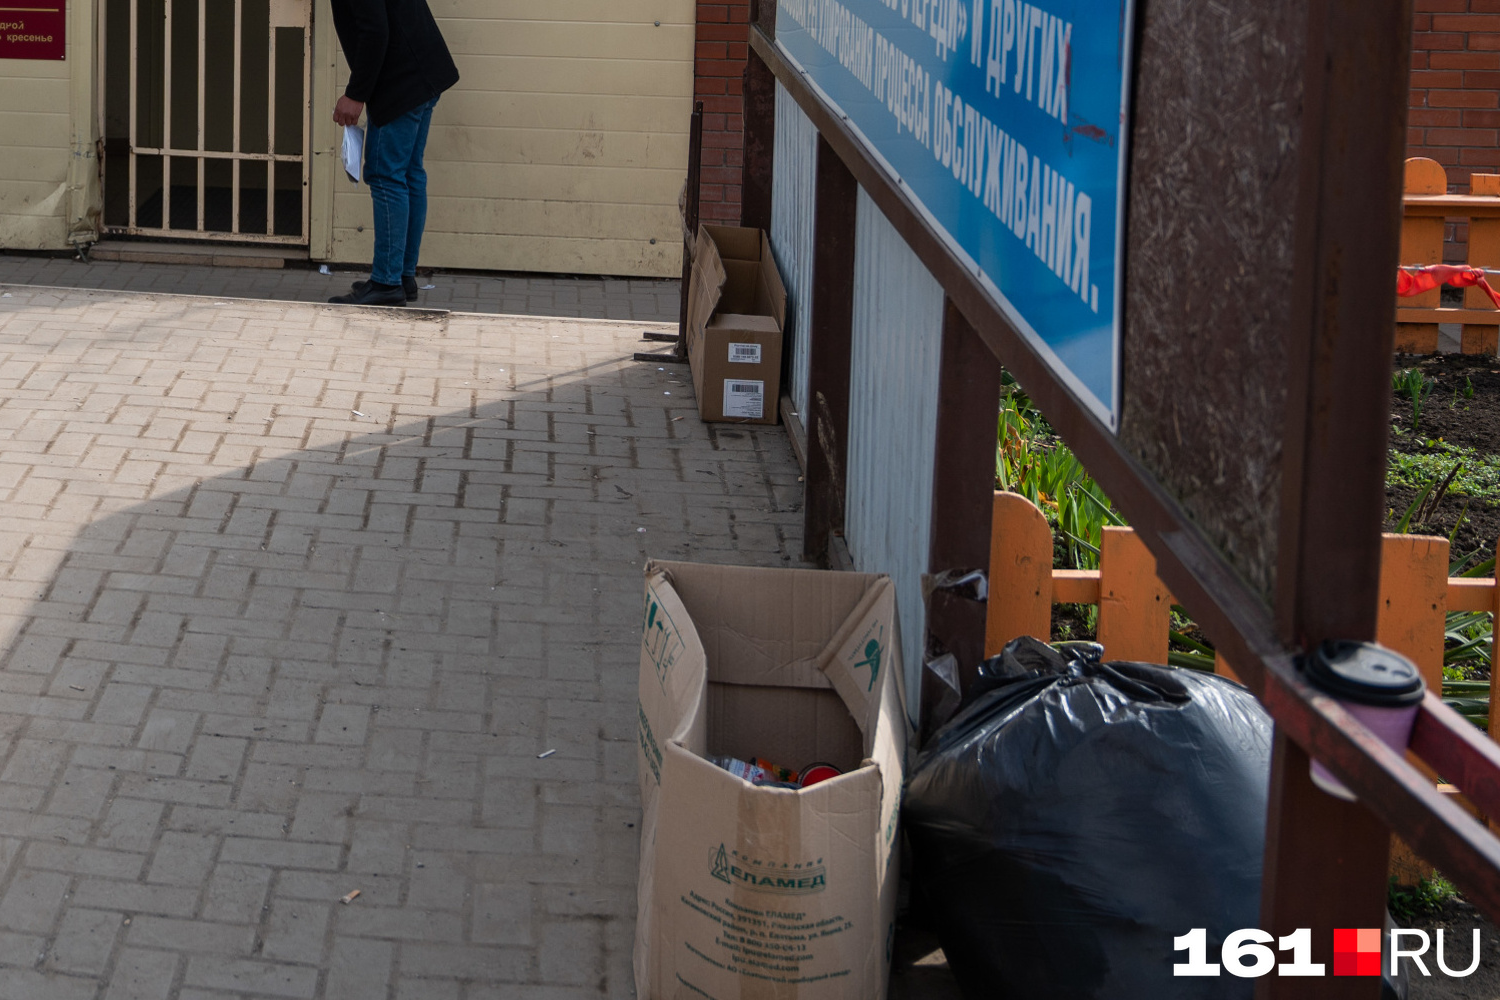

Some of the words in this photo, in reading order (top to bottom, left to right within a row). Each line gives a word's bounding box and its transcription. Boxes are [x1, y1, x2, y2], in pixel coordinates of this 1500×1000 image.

[874, 31, 930, 150] ПРОЦЕССА
[933, 81, 1099, 314] ОБСЛУЖИВАНИЯ.
[730, 865, 826, 889] ЕЛАМЕД
